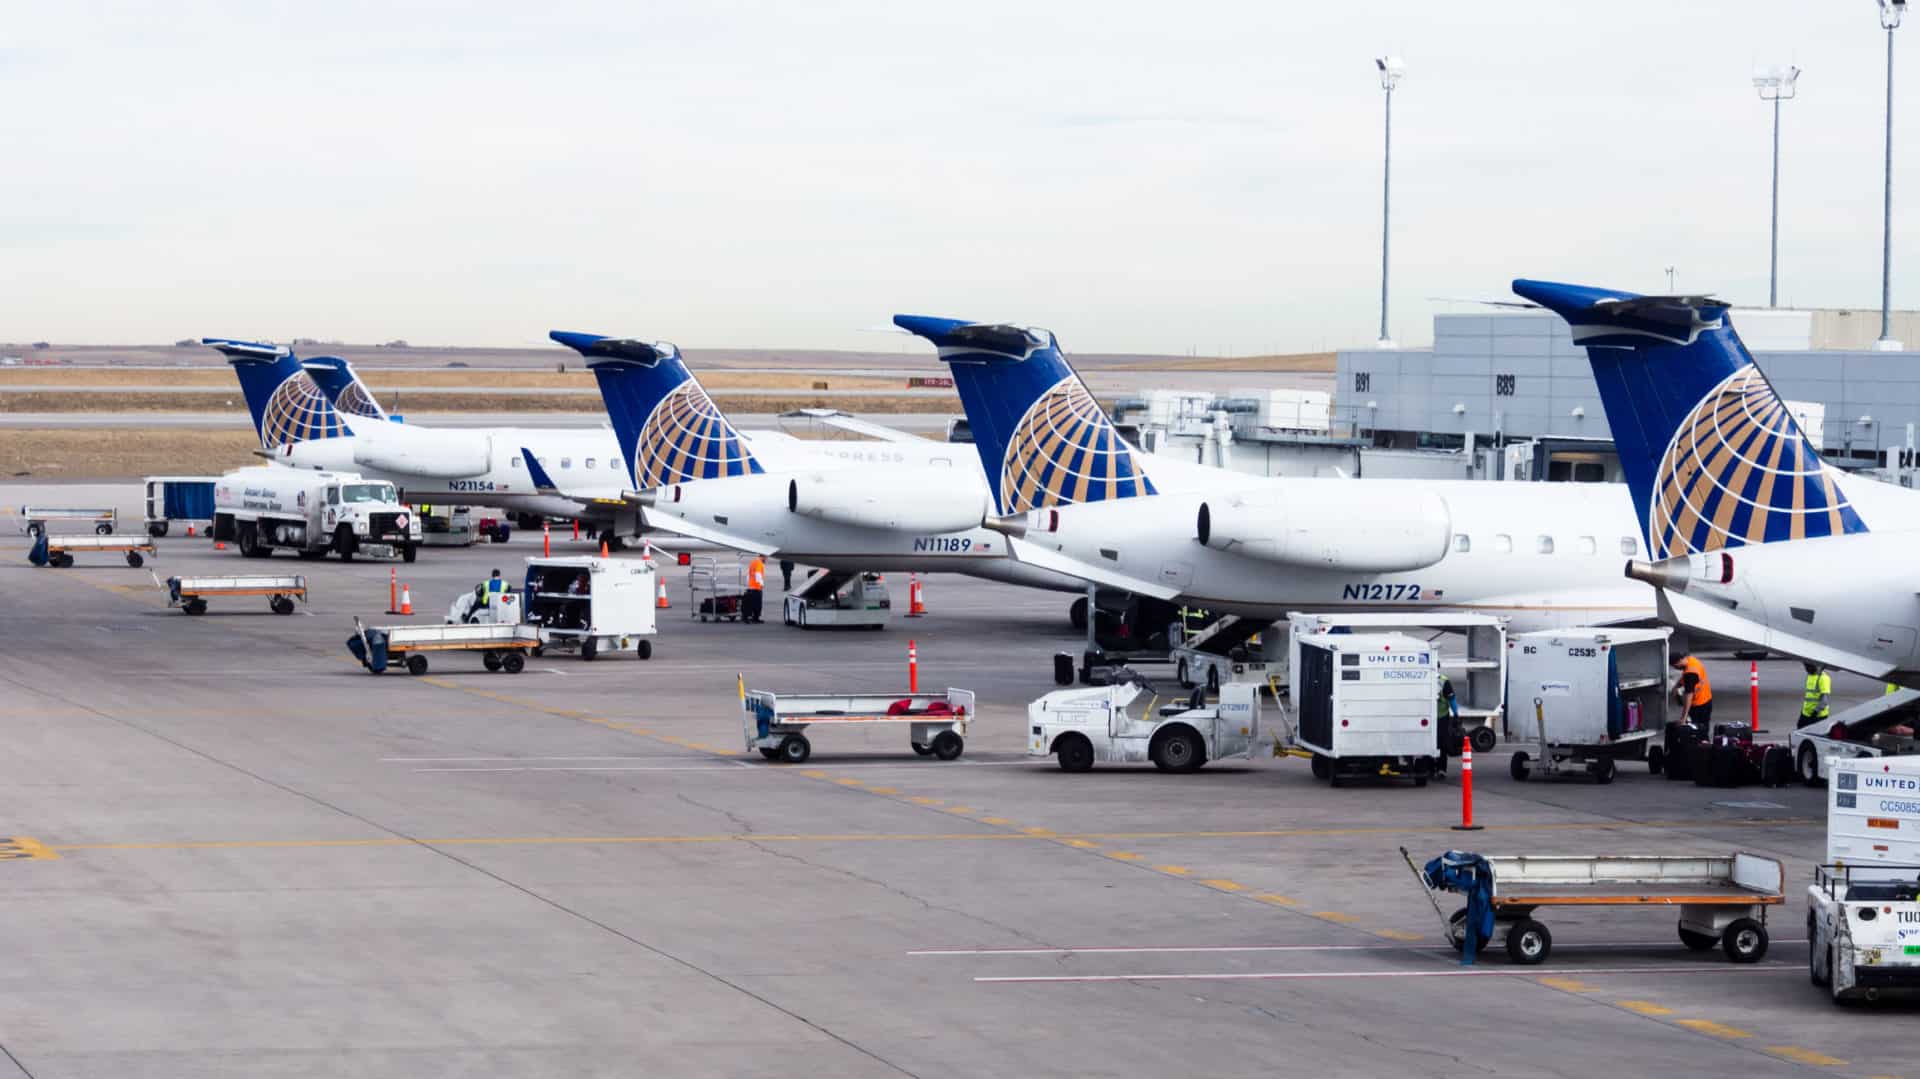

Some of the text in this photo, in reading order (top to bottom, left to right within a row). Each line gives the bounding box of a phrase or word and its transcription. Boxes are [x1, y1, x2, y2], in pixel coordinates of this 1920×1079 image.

[1355, 372, 1370, 392] B91
[1496, 374, 1515, 396] B89
[448, 480, 495, 491] N21154
[914, 537, 972, 552] N11189
[1343, 583, 1421, 601] N12172
[1523, 646, 1537, 655] BC
[1368, 655, 1416, 663] UNITED
[1865, 777, 1917, 791] UNITED
